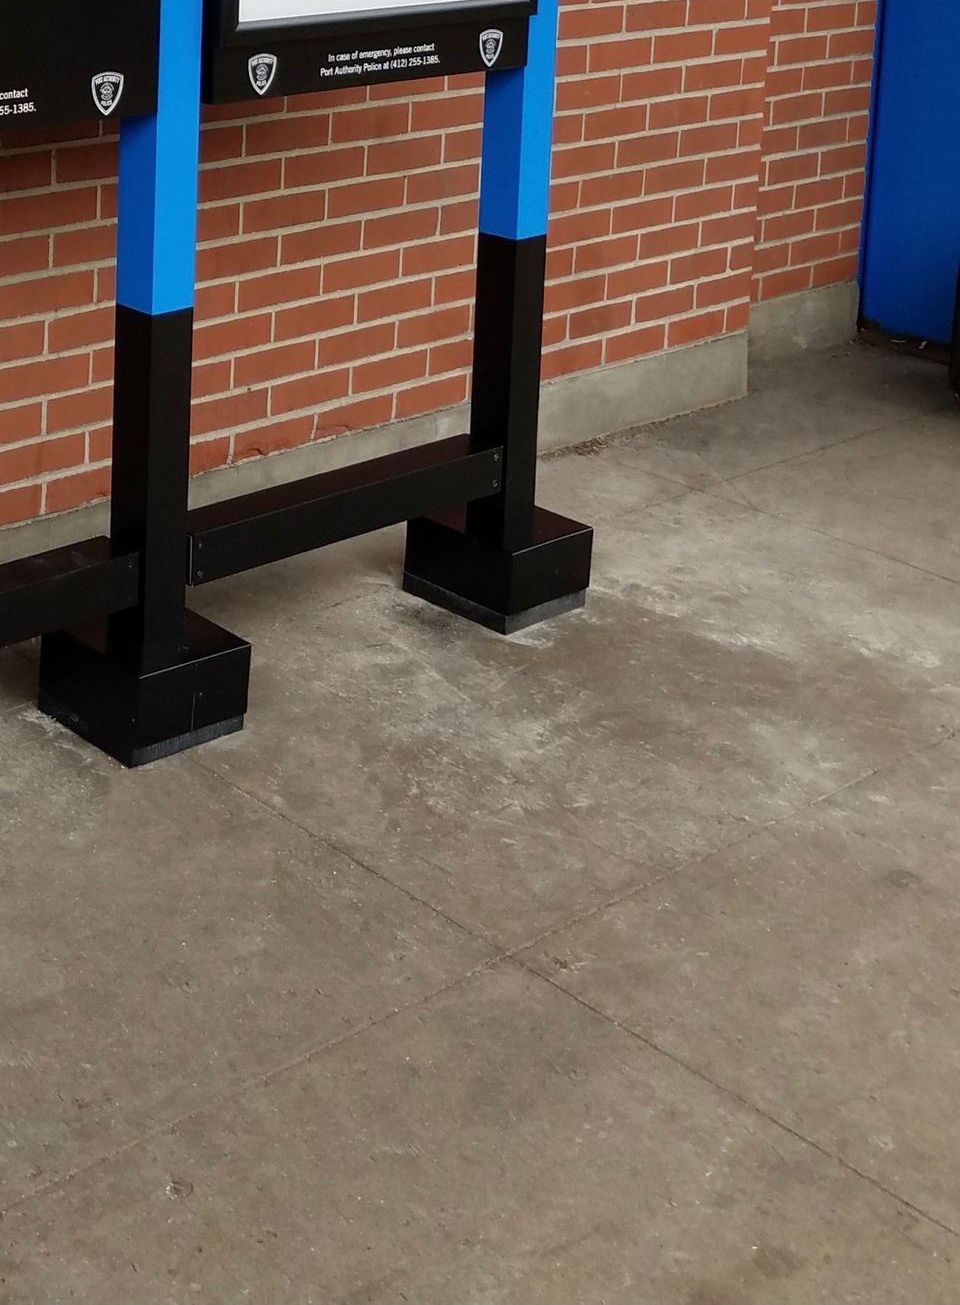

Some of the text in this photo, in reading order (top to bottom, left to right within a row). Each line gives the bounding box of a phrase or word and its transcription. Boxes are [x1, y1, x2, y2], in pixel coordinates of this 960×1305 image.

[328, 43, 435, 62] In case of emergency, please contact
[320, 55, 440, 76] Port Authority Police at (412) 255-1385.
[0, 88, 28, 100] contact
